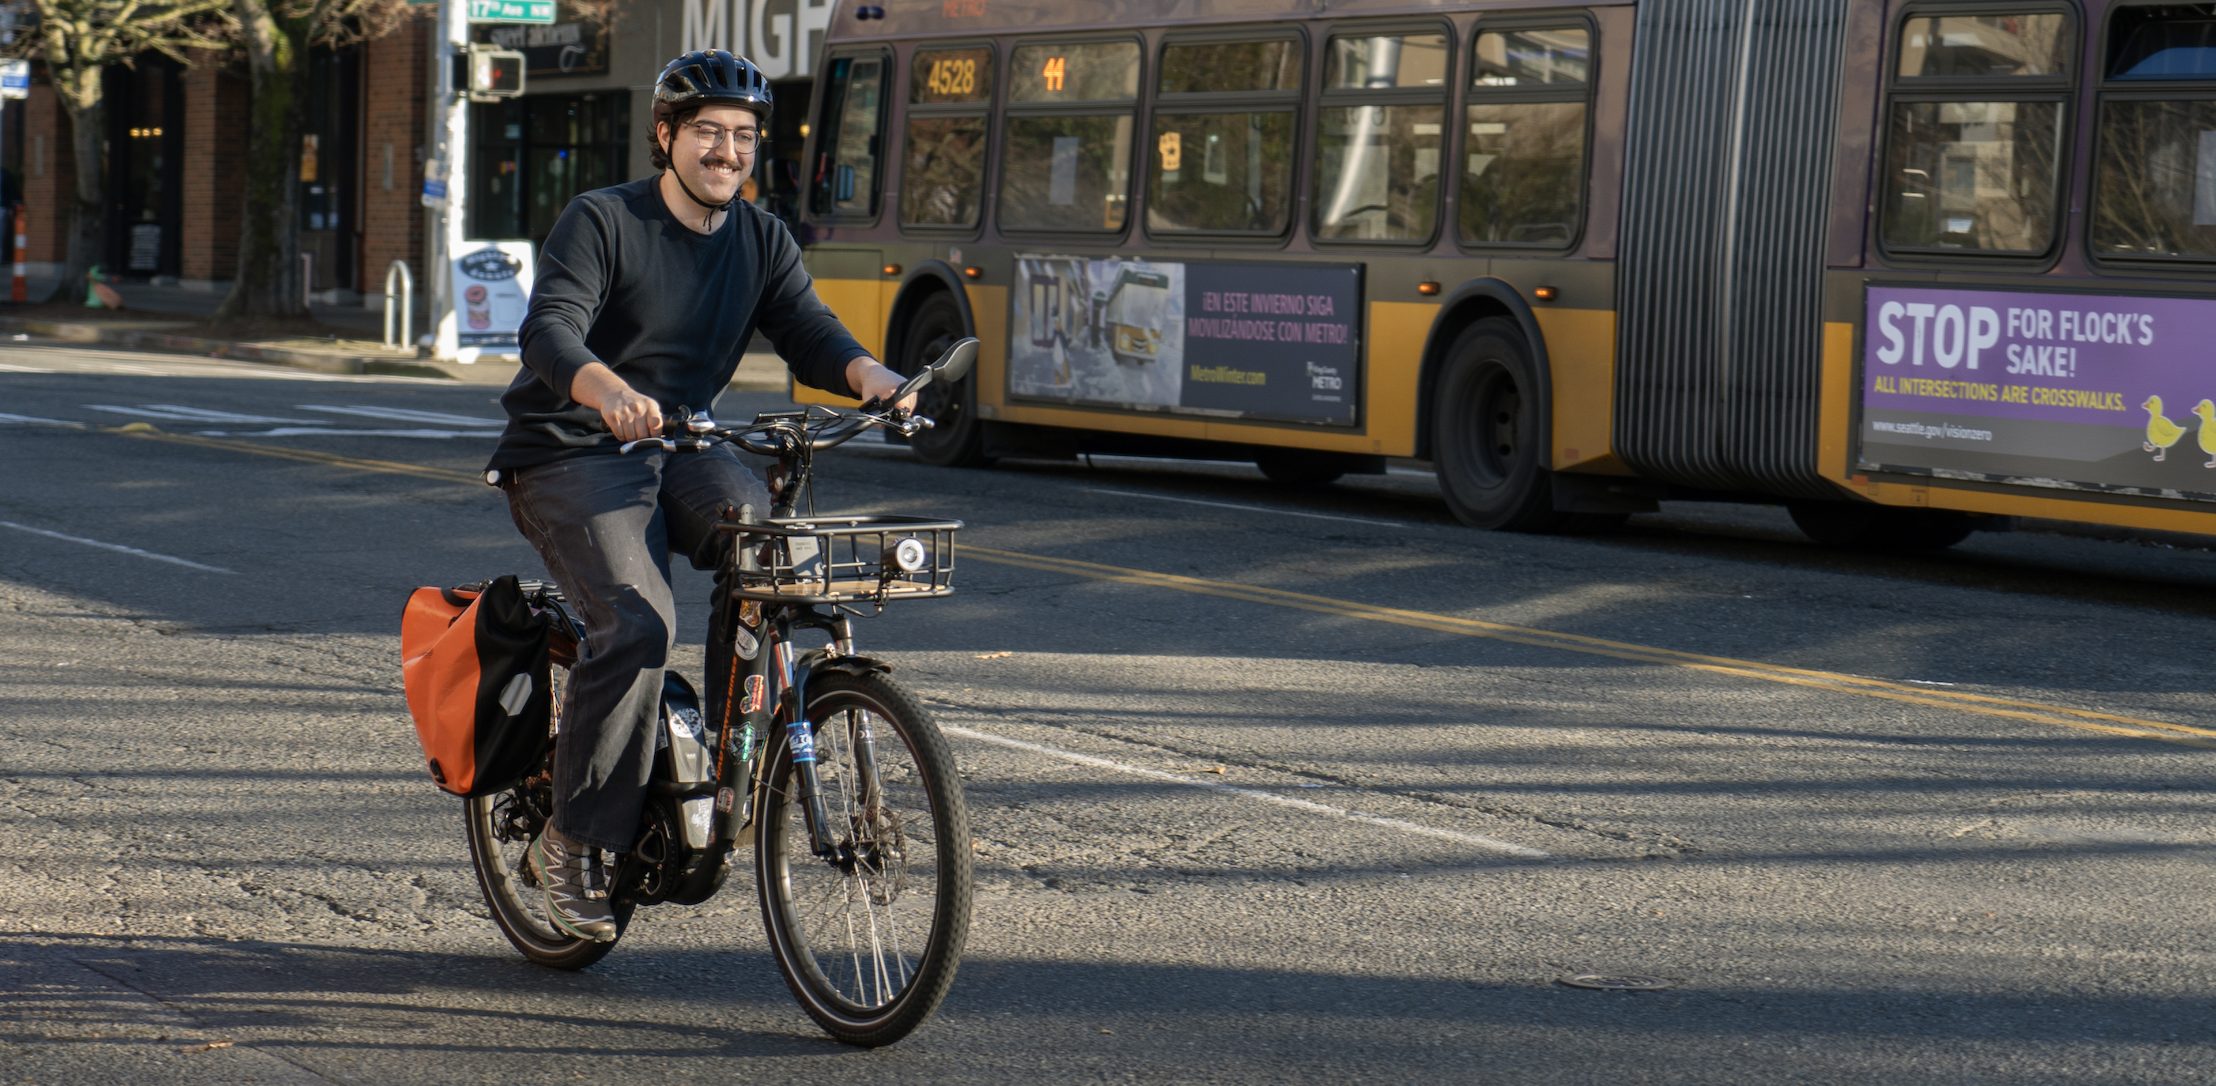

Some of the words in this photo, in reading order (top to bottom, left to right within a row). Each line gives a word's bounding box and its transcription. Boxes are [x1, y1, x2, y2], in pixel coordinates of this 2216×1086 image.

[502, 3, 524, 16] Ave
[928, 58, 975, 95] 4528
[1043, 57, 1066, 91] 44
[1223, 292, 1249, 313] ESTE
[1251, 293, 1305, 316] INVIERNO
[1306, 295, 1333, 316] SIGA
[1188, 312, 1275, 341] MOVILIZÁNDOSE
[1277, 322, 1302, 342] CON
[1304, 323, 1348, 344] METRO!
[1876, 300, 2000, 370] STOP
[2006, 307, 2054, 340] FOR
[2058, 310, 2154, 346] FLOCK'S
[1190, 364, 1266, 385] MetroWinter.com
[2005, 343, 2077, 378] SAKE!
[1312, 376, 1342, 390] METRO
[1874, 375, 1897, 394] ALL
[1898, 377, 1998, 402] INTERSECTIONS
[2000, 385, 2029, 404] ARE
[2031, 387, 2127, 412] CROSSWALKS.
[1872, 420, 1993, 442] www.seattle.gov/visionzero
